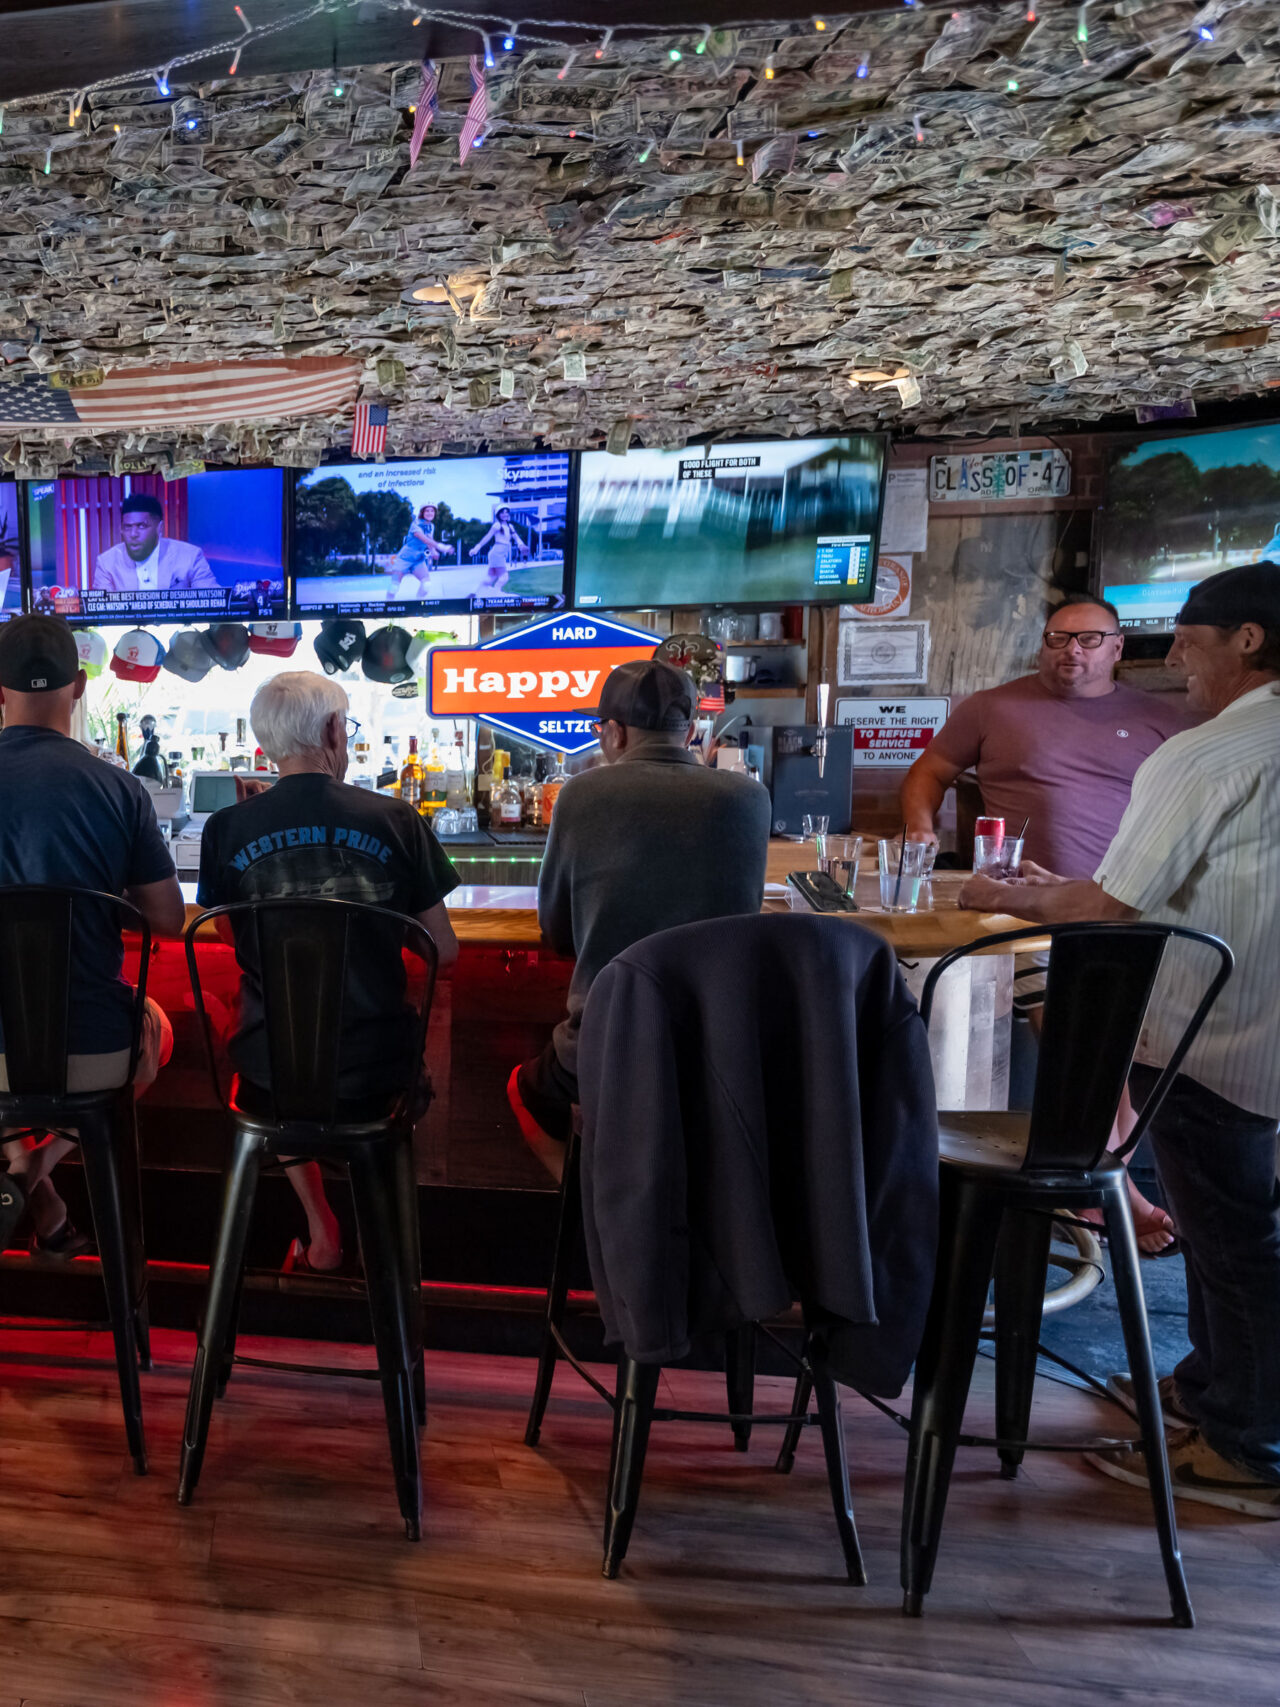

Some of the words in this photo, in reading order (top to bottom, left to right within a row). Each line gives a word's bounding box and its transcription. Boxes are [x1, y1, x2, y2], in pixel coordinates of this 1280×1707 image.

[683, 460, 700, 469] GOOD
[701, 459, 724, 468] FLIGHT
[725, 458, 738, 467] FOR
[738, 457, 756, 466] BOTH
[358, 471, 373, 479] and
[385, 468, 422, 478] increased
[422, 466, 437, 475] risk
[682, 470, 691, 479] OF
[692, 469, 712, 478] THESE
[935, 458, 994, 493] CLASS
[377, 480, 387, 488] of
[387, 478, 425, 487] infections
[120, 592, 134, 600] BEST
[135, 591, 160, 600] VERSION
[160, 591, 168, 599] OF
[169, 590, 197, 599] DESHAUN
[199, 589, 226, 598] WATSON?
[87, 603, 96, 611] CLE
[105, 602, 129, 611] WATSON'S
[147, 601, 154, 610] OF
[154, 600, 179, 610] SCHEDULE"
[180, 600, 185, 608] IN
[185, 599, 210, 608] SHOULDER
[210, 599, 226, 608] REHAB
[258, 608, 272, 616] FS1
[552, 627, 597, 640] HARD
[442, 668, 600, 699] Happy
[879, 705, 906, 714] WE
[844, 717, 886, 726] RESERVE
[890, 717, 907, 726] THE
[911, 716, 939, 726] RIGHT
[538, 720, 593, 734] SELTZE
[860, 730, 875, 738] TO
[878, 729, 922, 738] REFUSE
[868, 739, 912, 748] SERVICE
[863, 752, 875, 760] TO
[878, 752, 917, 760] ANYONE
[228, 826, 327, 872] WESTERN
[332, 827, 394, 865] PRIDE
